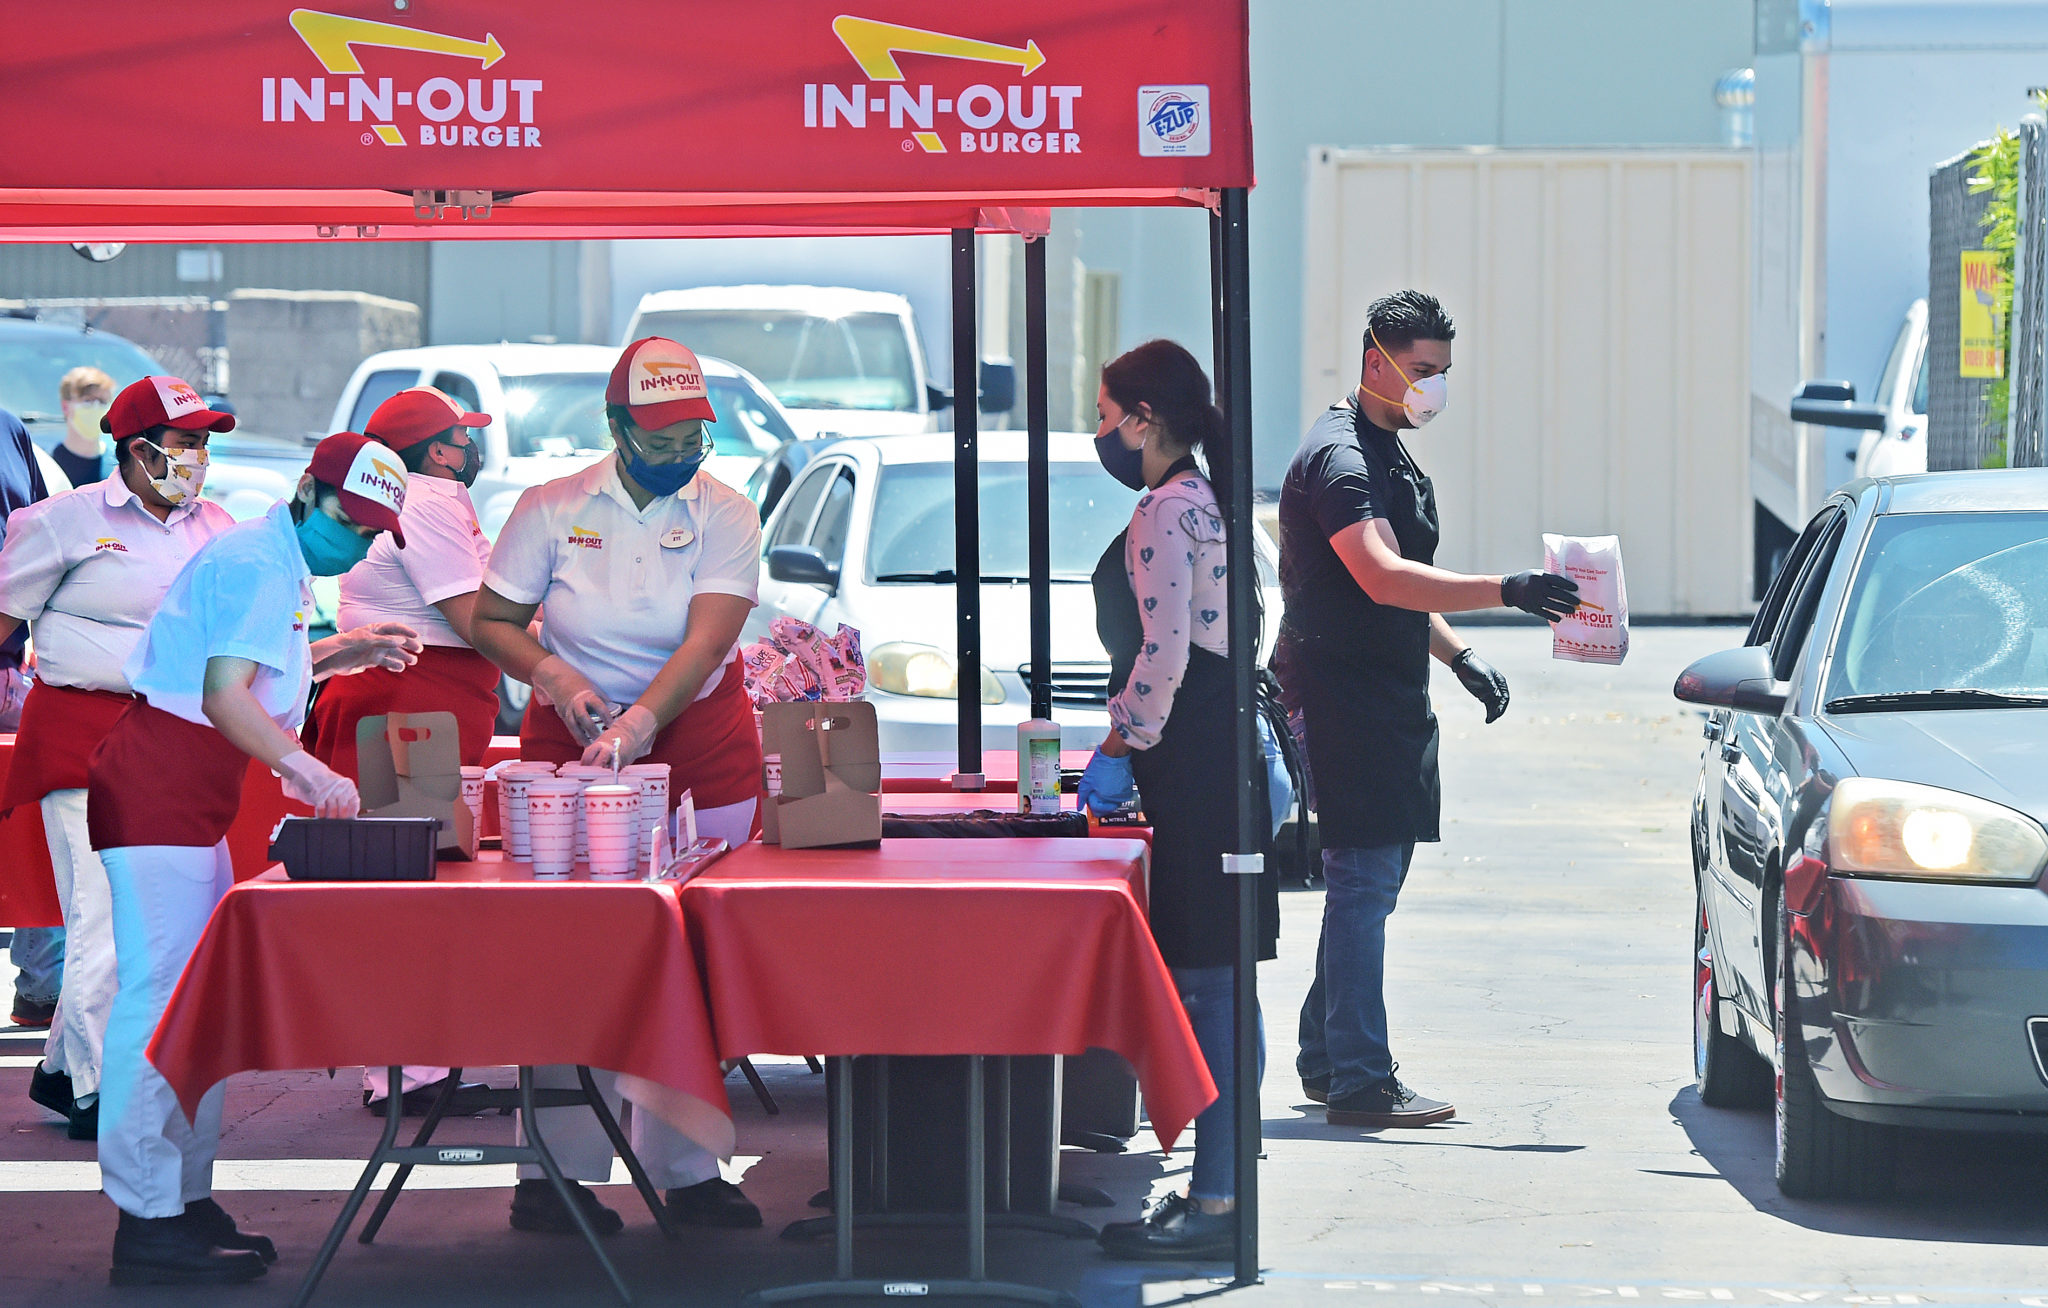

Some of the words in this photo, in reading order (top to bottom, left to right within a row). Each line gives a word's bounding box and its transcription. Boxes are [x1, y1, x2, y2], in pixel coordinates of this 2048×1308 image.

[262, 77, 543, 123] IN-N-OUT
[804, 83, 1082, 130] IN-N-OUT
[420, 124, 542, 147] BURGER
[960, 131, 1082, 153] BURGER
[640, 374, 699, 391] IN-N-OUT
[752, 649, 769, 666] CAPE
[1323, 1281, 1928, 1304] PARKING
